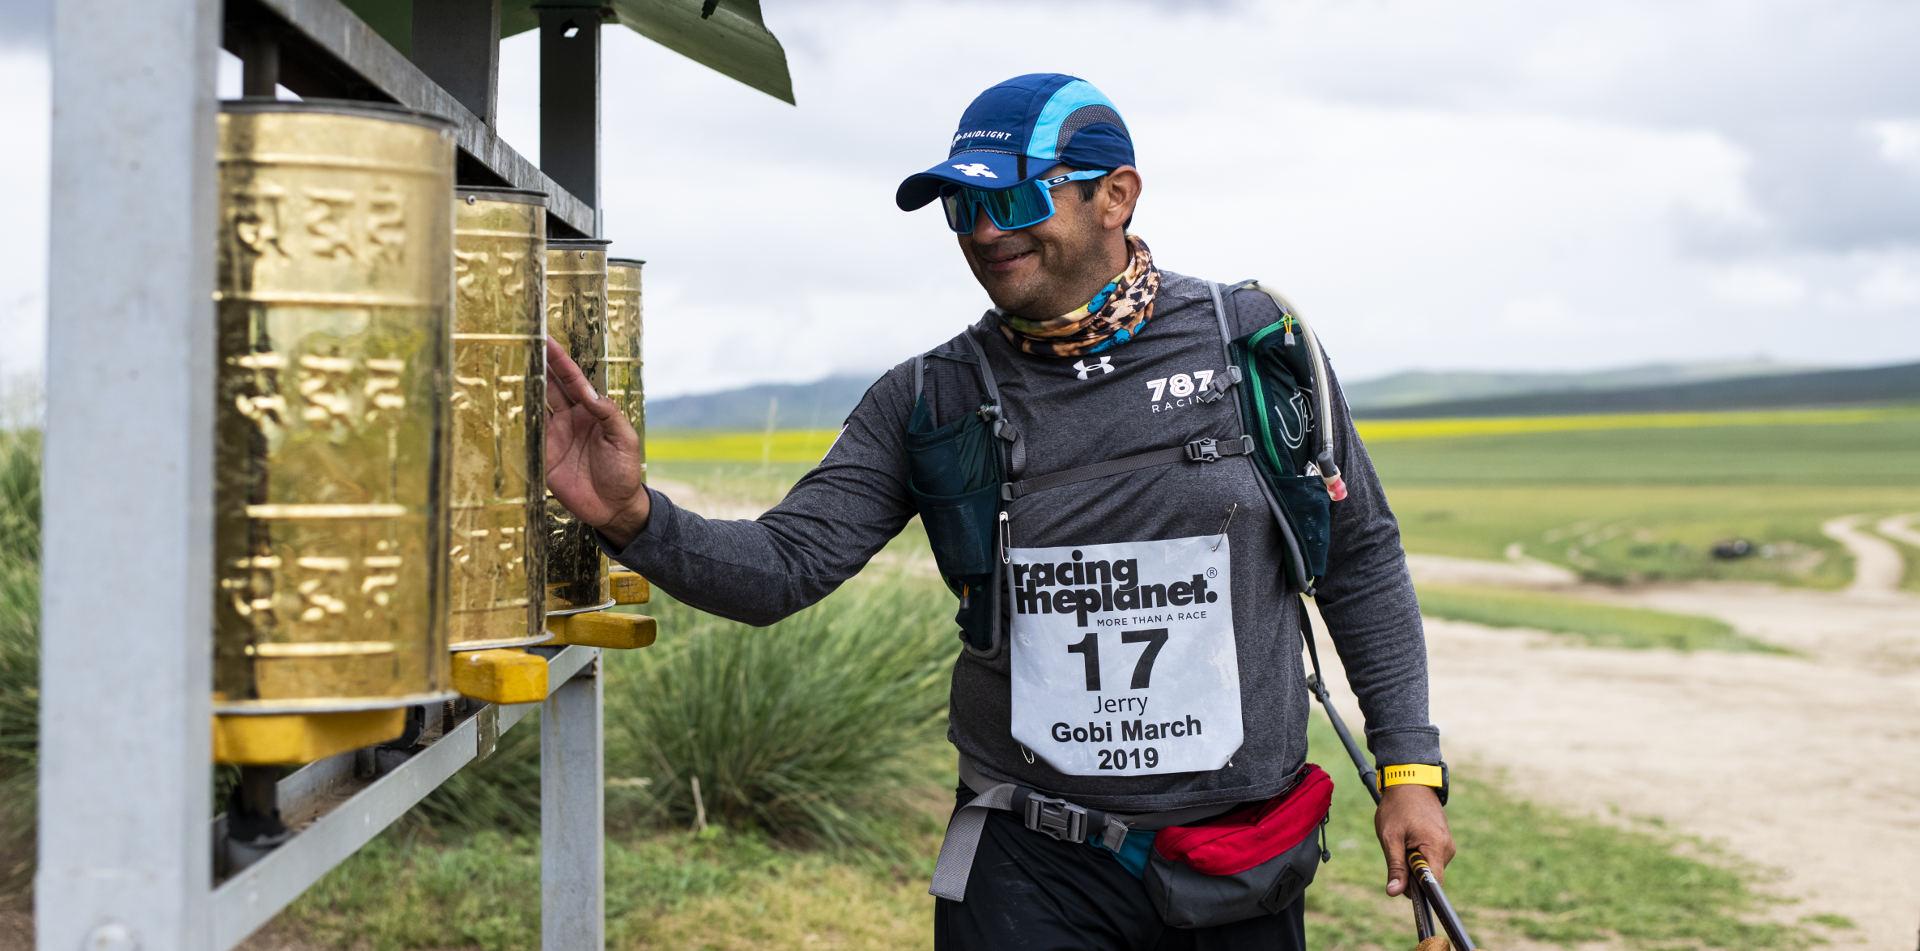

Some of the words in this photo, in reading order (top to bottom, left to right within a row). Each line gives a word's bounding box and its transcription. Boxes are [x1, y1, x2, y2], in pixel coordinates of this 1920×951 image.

[1146, 370, 1214, 402] 787
[1152, 396, 1204, 413] RACIN
[1013, 550, 1139, 591] racing
[1097, 617, 1128, 627] MORE
[1132, 614, 1162, 624] THAN
[1166, 613, 1174, 622] A
[1178, 611, 1207, 620] RACE
[1067, 628, 1169, 691] 17
[1093, 695, 1148, 716] Jerry
[1051, 721, 1113, 743] Gobi
[1121, 714, 1202, 742] March
[1098, 747, 1159, 770] 2019
